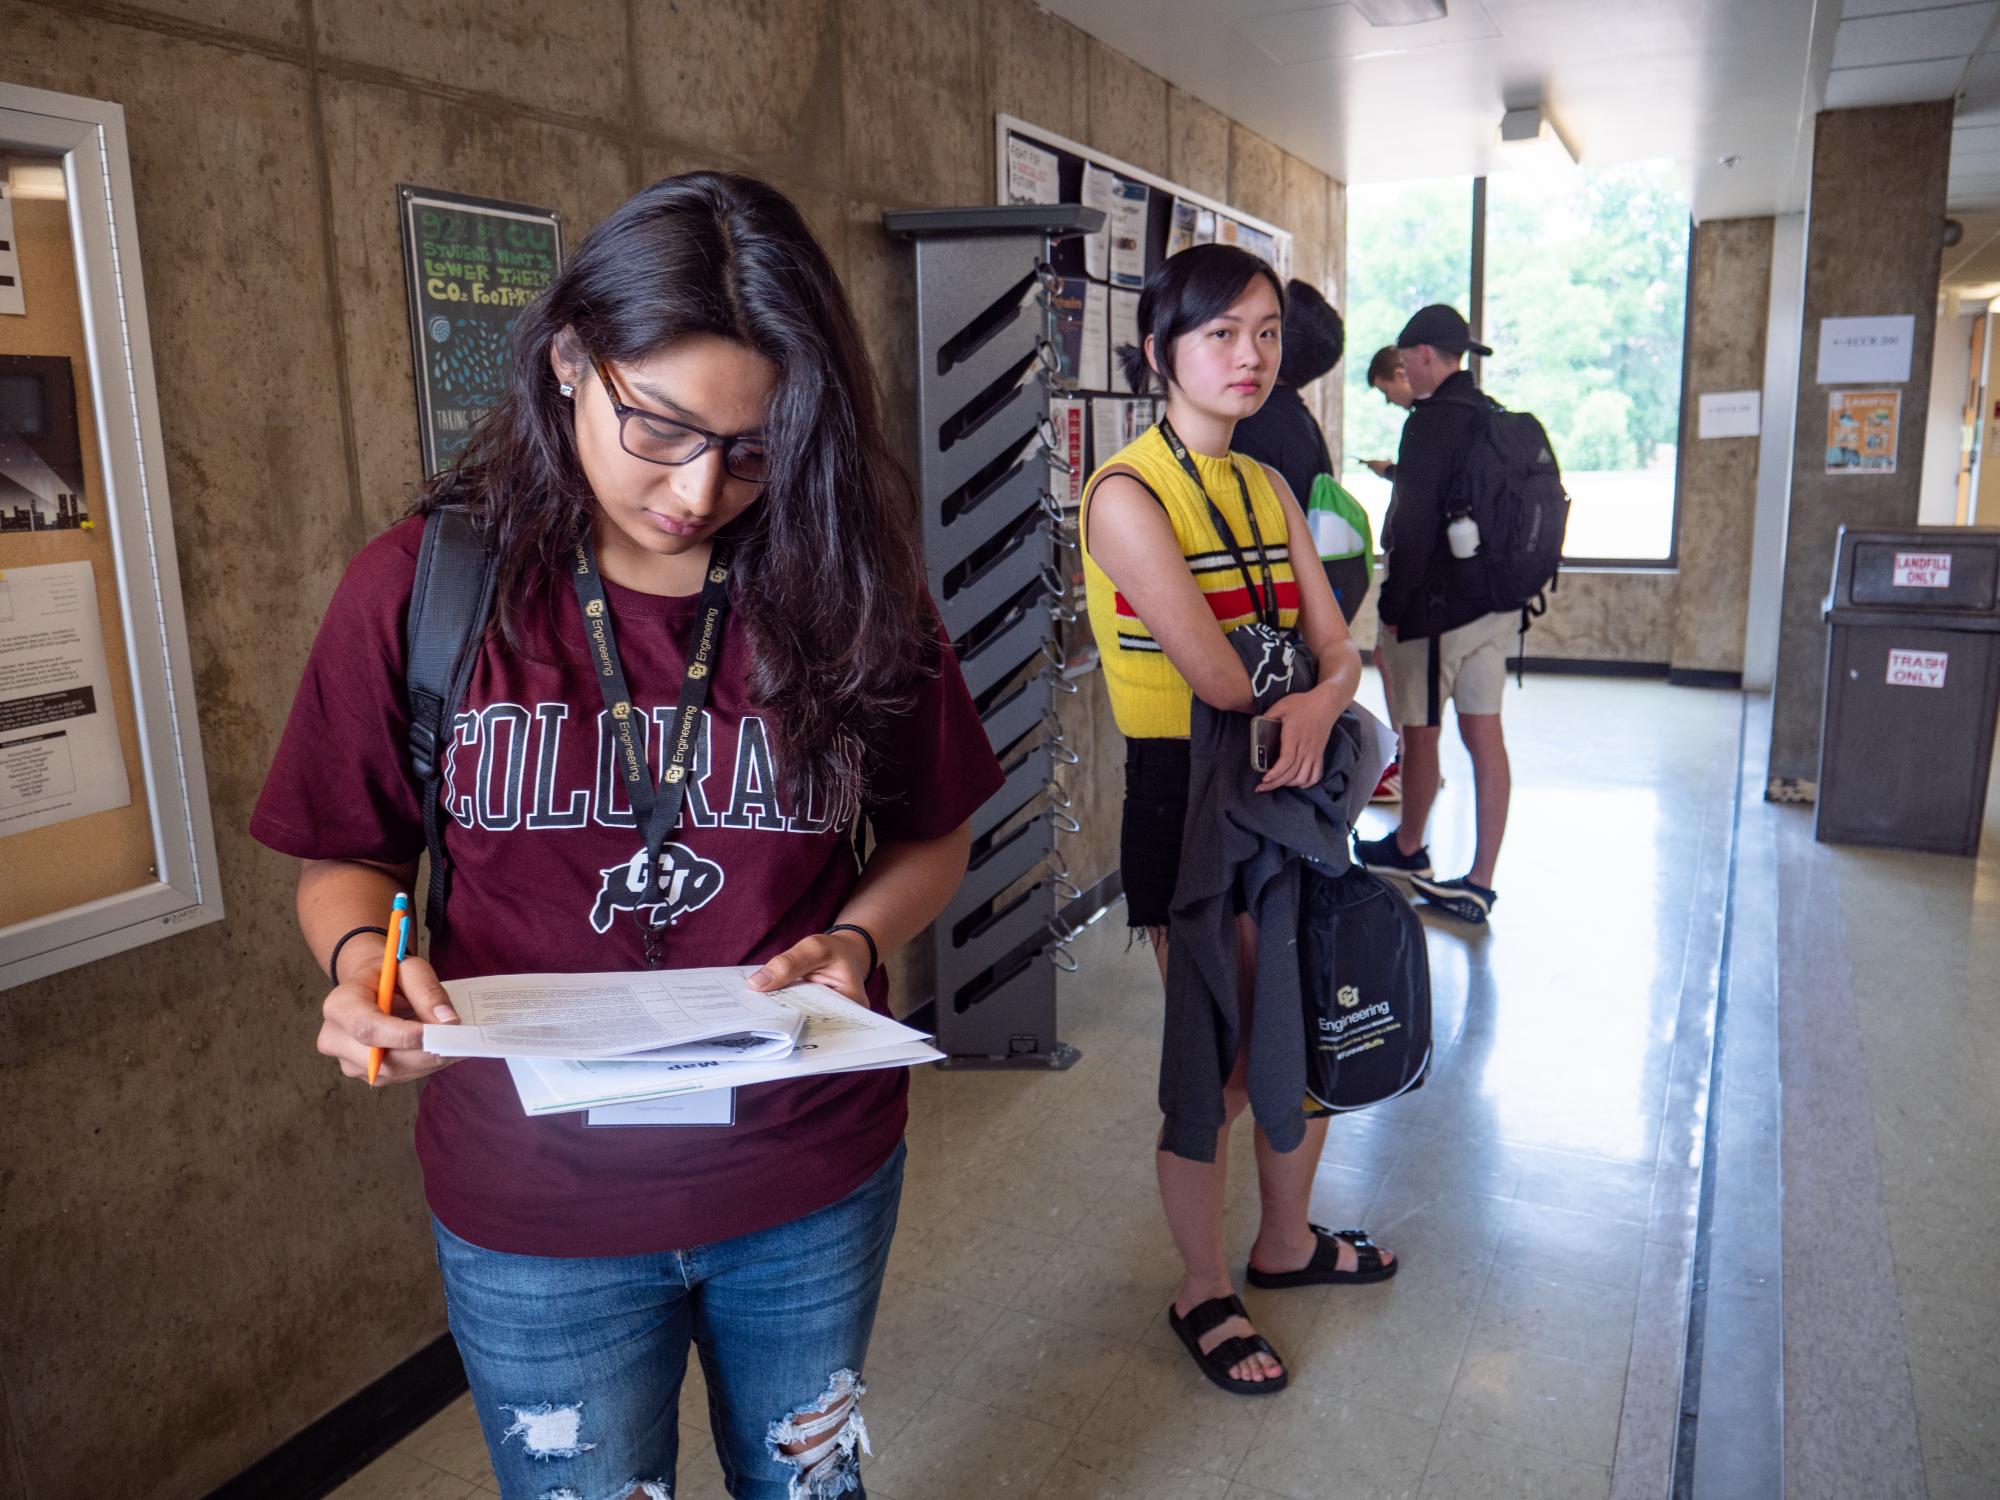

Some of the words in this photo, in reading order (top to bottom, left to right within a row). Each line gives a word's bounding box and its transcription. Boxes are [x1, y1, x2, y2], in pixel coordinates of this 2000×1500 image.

[505, 223, 549, 250] CU
[423, 241, 491, 262] STUDENTS
[424, 259, 490, 280] LOWER
[497, 267, 550, 286] THEIR
[1896, 556, 1950, 571] LANDFILL
[1907, 571, 1938, 585] ONLY
[593, 619, 613, 677] Engineering
[696, 607, 719, 662] Engineering
[1893, 655, 1946, 669] TRASH
[1894, 671, 1938, 685] ONLY
[673, 705, 698, 763] Engineering
[621, 721, 640, 782] Engineering
[1318, 1001, 1390, 1033] Engineering
[668, 1060, 720, 1071] Map
